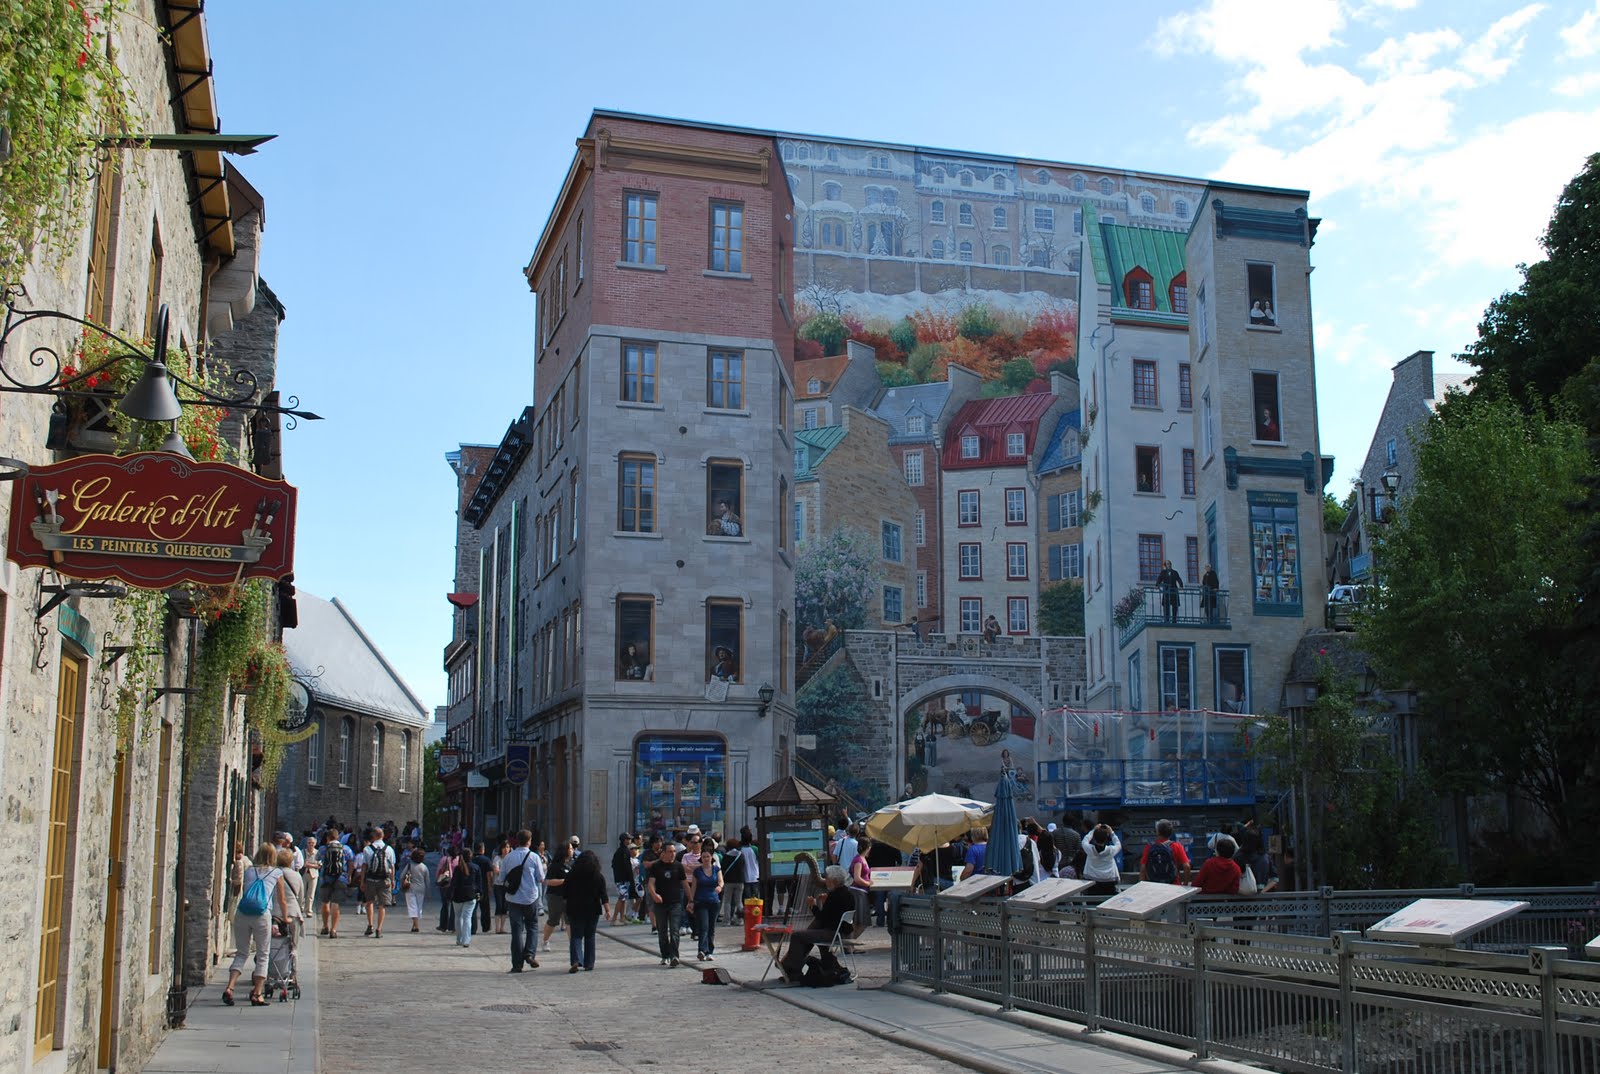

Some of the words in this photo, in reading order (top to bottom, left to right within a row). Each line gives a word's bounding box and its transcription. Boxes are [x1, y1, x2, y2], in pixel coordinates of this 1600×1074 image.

[62, 476, 168, 534] Galerie
[161, 485, 242, 536] d'Art
[73, 538, 94, 550] LES
[101, 540, 159, 555] PEINTRES
[164, 543, 232, 560] QUEBECOIS
